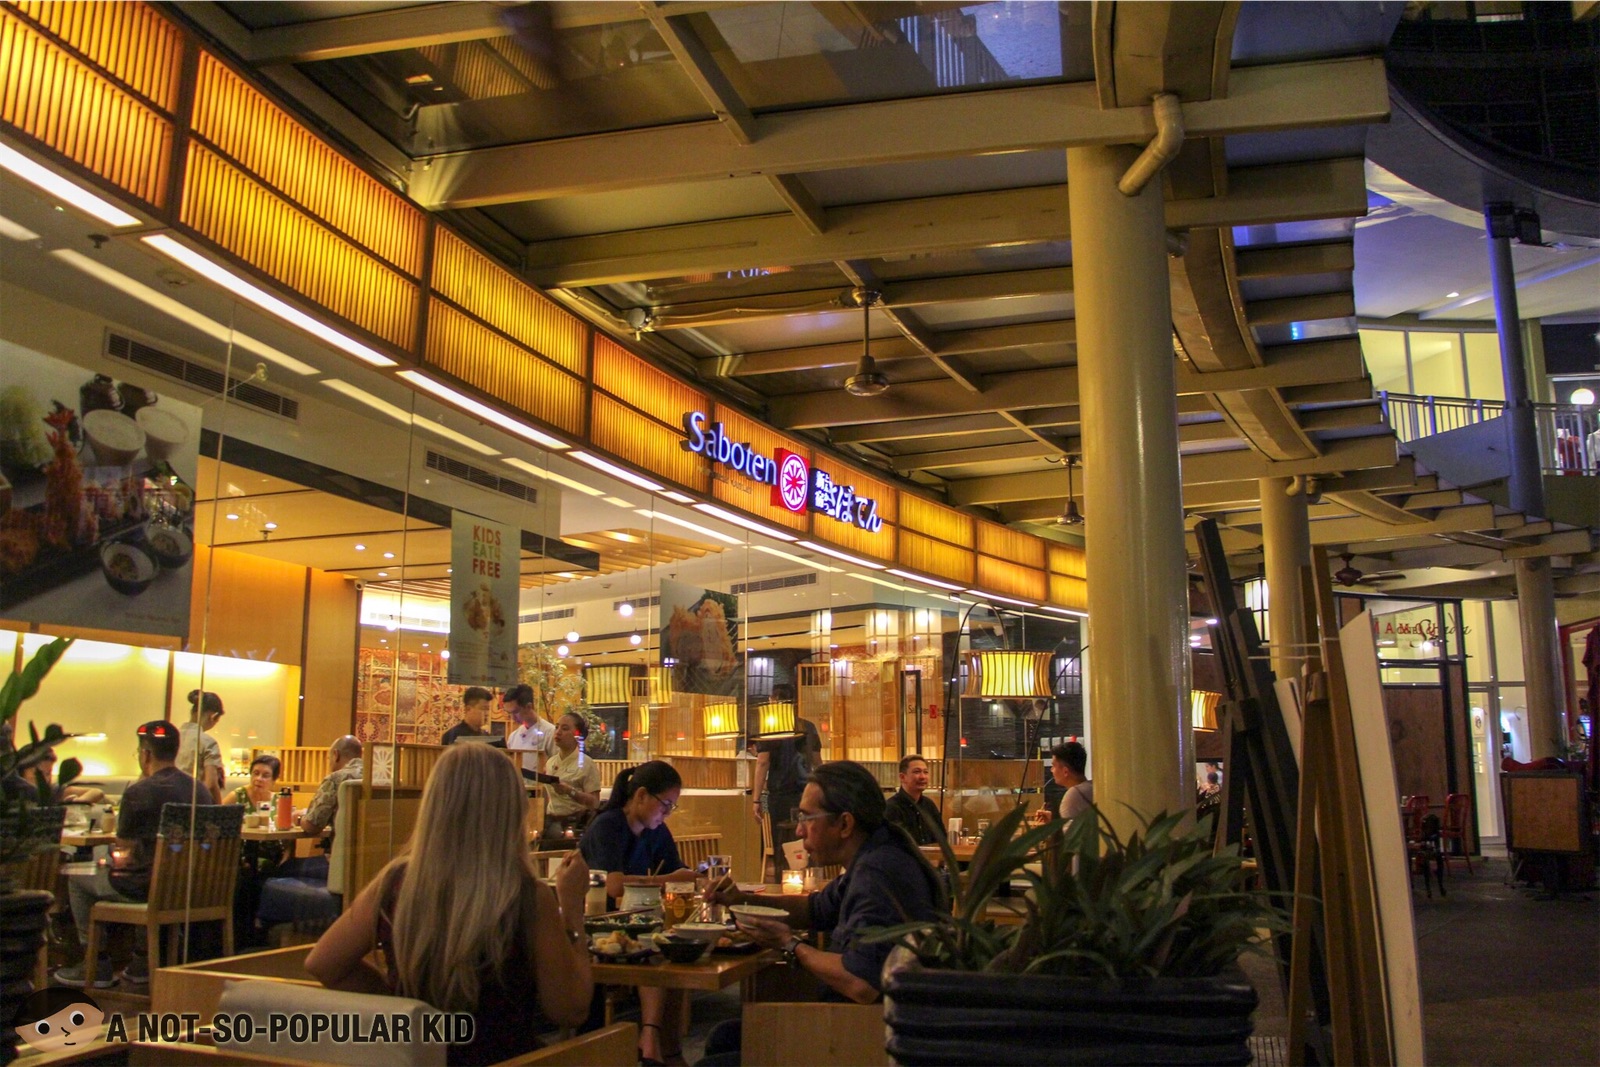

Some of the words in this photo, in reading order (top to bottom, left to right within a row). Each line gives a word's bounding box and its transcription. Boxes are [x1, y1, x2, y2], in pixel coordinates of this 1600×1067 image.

[687, 411, 778, 486] Saboten
[472, 524, 501, 546] KIDS
[472, 558, 501, 579] FREE
